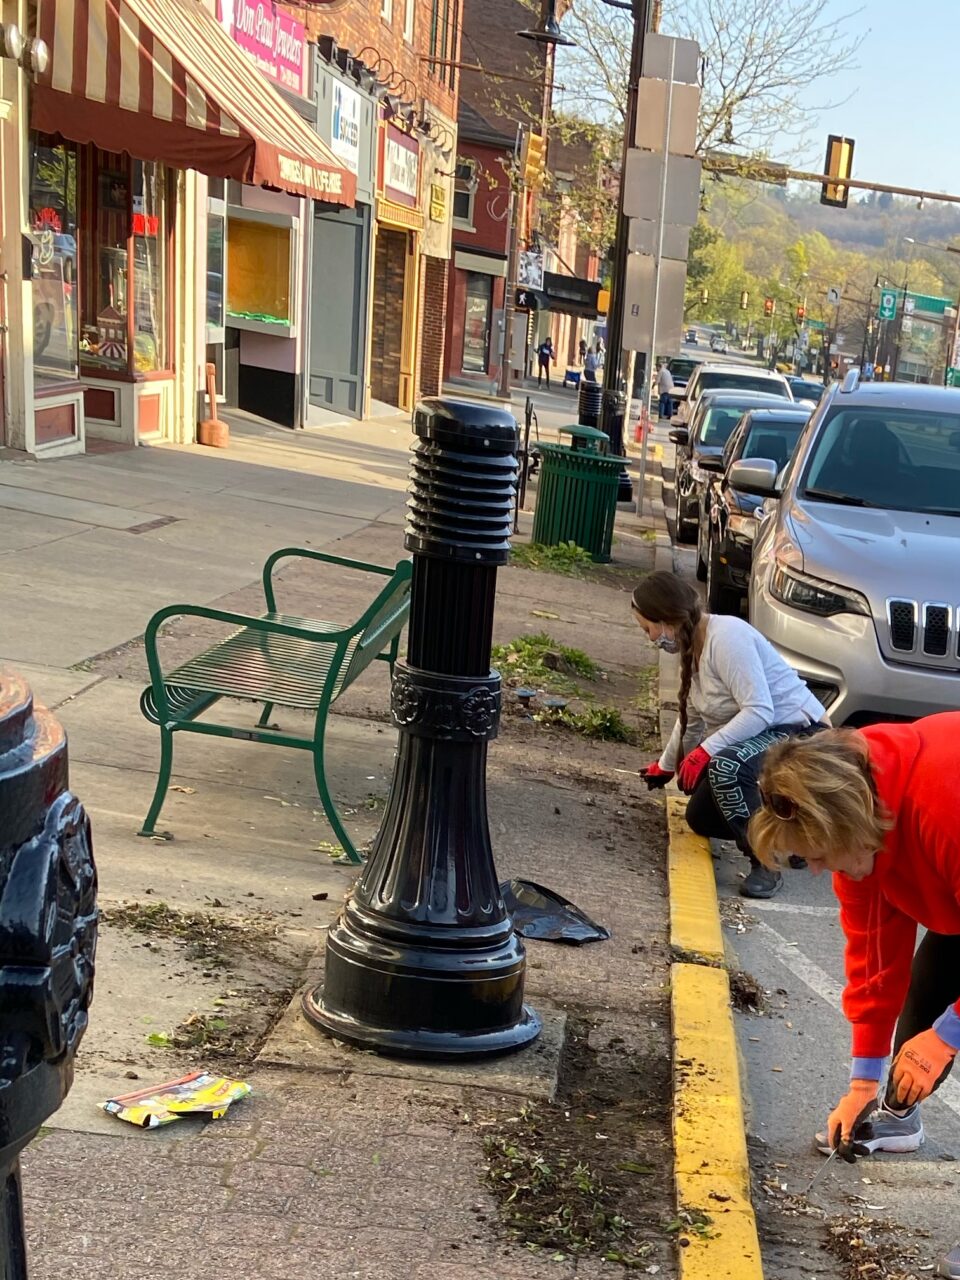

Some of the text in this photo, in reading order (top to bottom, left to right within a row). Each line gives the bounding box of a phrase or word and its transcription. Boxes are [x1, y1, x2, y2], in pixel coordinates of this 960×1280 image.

[255, 3, 273, 48] Paul
[272, 16, 302, 66] Jewelers
[708, 755, 751, 821] PARK
